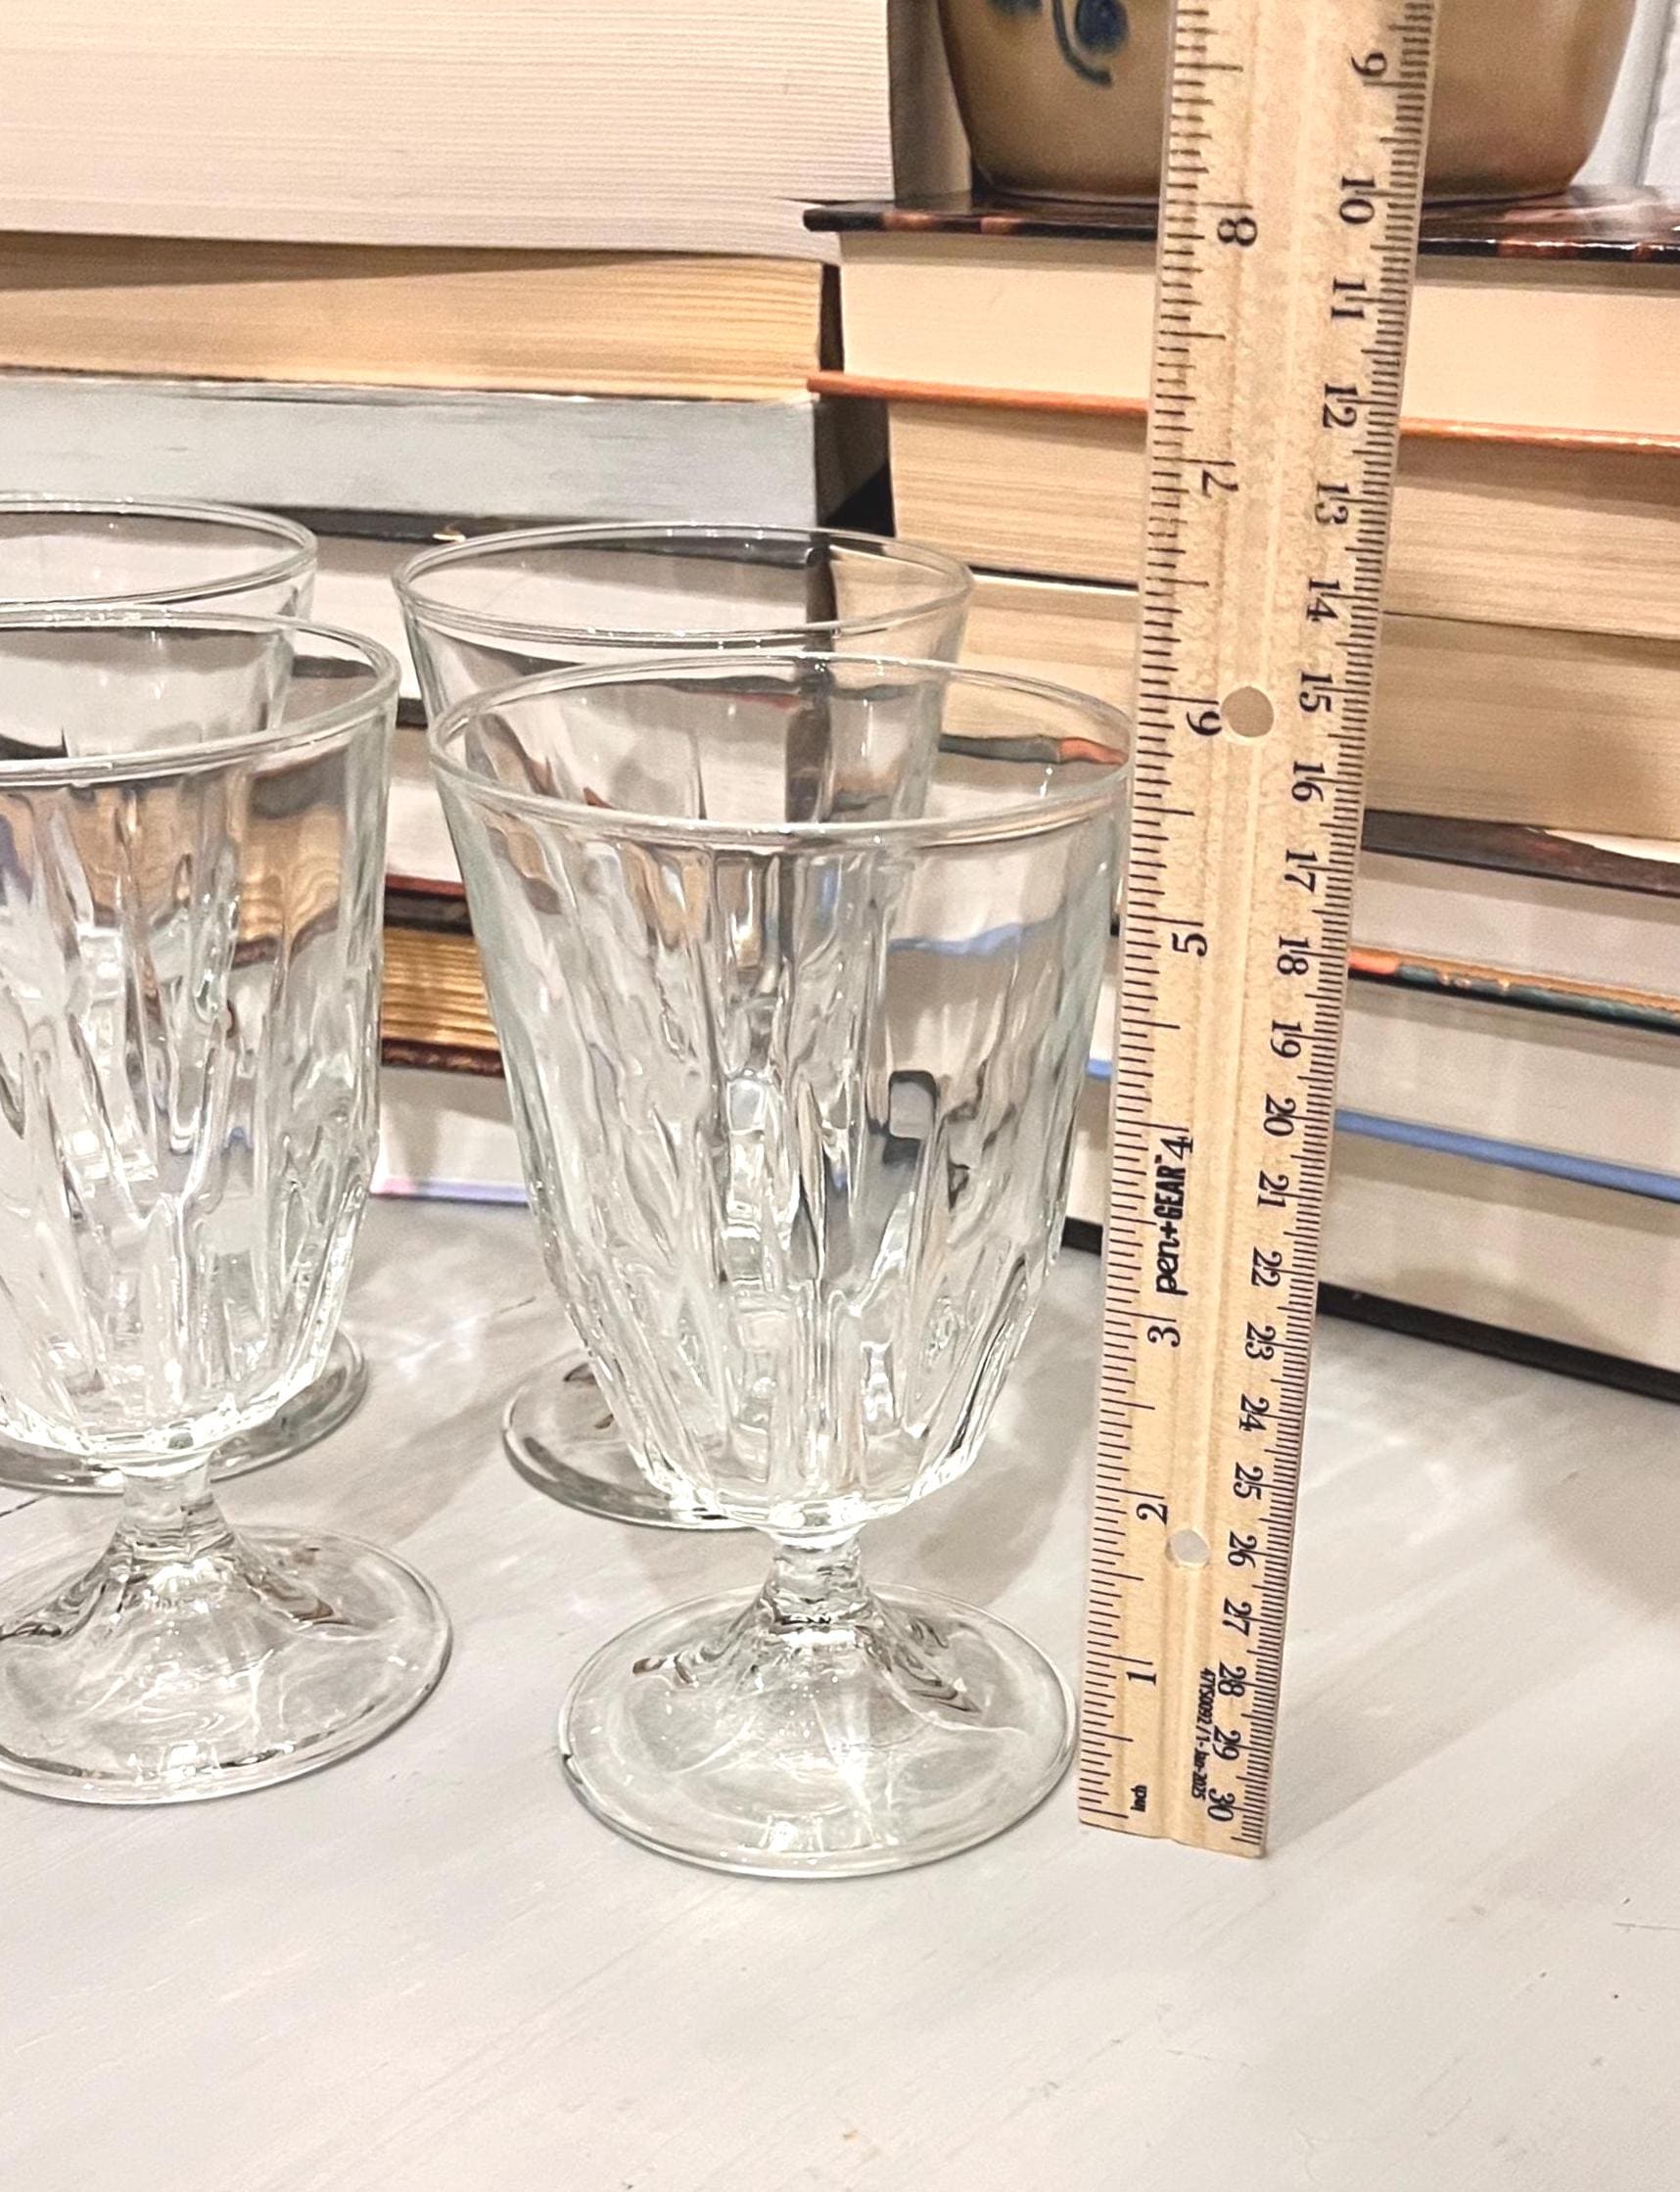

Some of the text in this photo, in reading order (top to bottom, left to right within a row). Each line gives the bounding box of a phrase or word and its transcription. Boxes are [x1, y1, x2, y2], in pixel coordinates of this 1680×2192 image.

[1351, 52, 1387, 77] 9
[1338, 176, 1376, 224] 10
[1217, 217, 1258, 247] 8
[1330, 278, 1367, 321] 11
[1323, 383, 1358, 429] 12
[1202, 469, 1238, 497] 7
[1315, 481, 1350, 526] 13
[1306, 578, 1340, 623] 14
[1299, 671, 1332, 714] 15
[1187, 711, 1222, 736] 6
[1291, 761, 1325, 802] 16
[1283, 849, 1318, 893] 17
[1172, 932, 1207, 957] 5
[1277, 935, 1309, 976] 18
[1270, 1019, 1302, 1058] 19
[1263, 1094, 1296, 1137] 20
[1161, 1136, 1193, 1160] 4
[1257, 1170, 1289, 1208] 21
[1251, 1246, 1283, 1286] 22
[1147, 1325, 1181, 1347] 3
[1245, 1322, 1276, 1361] 23
[1238, 1393, 1270, 1432] 24
[1233, 1462, 1263, 1500] 25
[1136, 1504, 1168, 1525] 2
[1228, 1531, 1258, 1568] 26
[1222, 1598, 1252, 1636] 27
[1127, 1670, 1157, 1687] 1
[1217, 1661, 1246, 1699] 28
[1213, 1725, 1241, 1761] 29
[1207, 1788, 1236, 1822] 30
